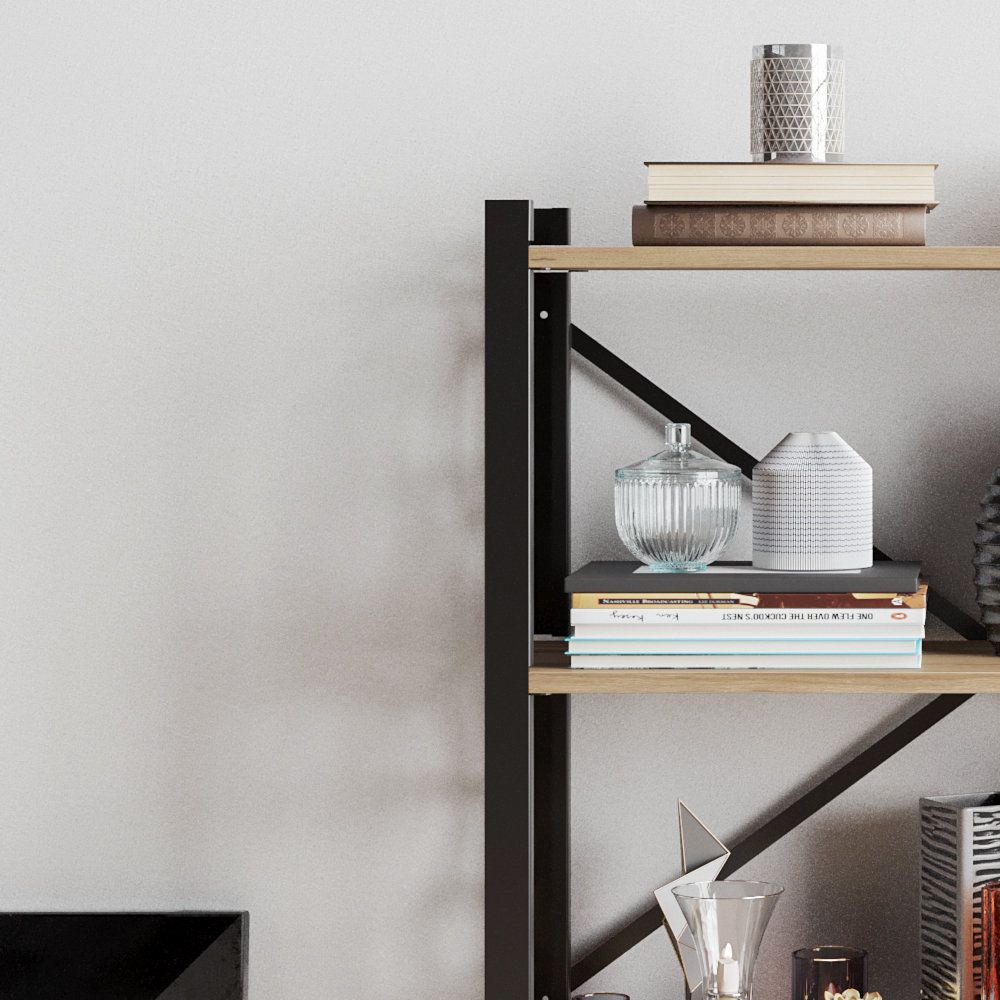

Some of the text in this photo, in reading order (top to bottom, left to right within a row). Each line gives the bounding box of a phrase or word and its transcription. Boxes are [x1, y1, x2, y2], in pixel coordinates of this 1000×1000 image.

[721, 612, 874, 621] ONE FLEW OVER THE CUCKOO'S NEST
